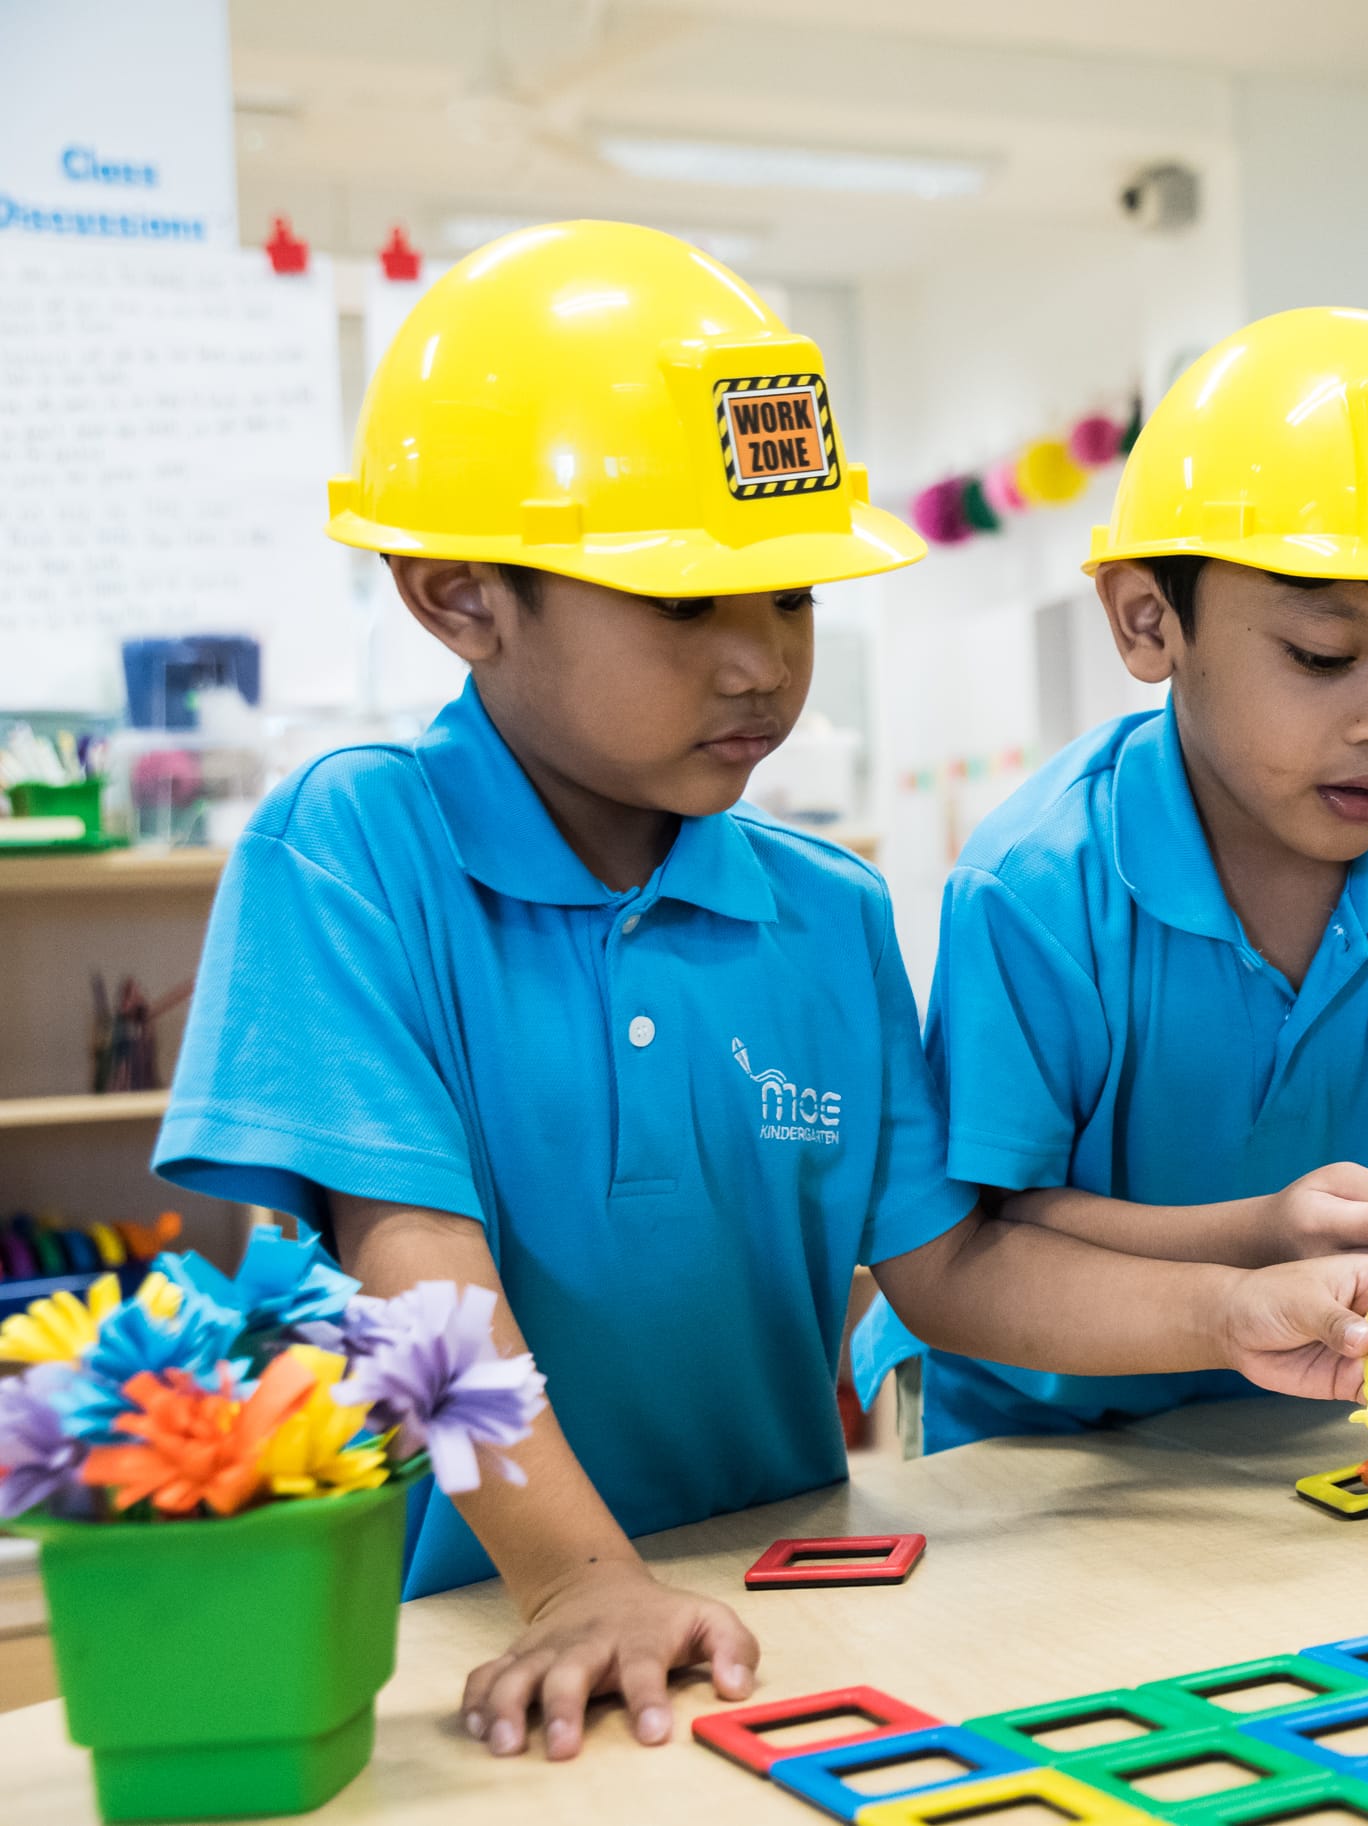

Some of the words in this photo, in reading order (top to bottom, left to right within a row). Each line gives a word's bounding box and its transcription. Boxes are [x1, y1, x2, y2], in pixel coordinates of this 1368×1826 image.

[733, 399, 812, 436] WORK
[748, 437, 811, 473] ZONE
[760, 1124, 839, 1144] KINDERGARTEN
